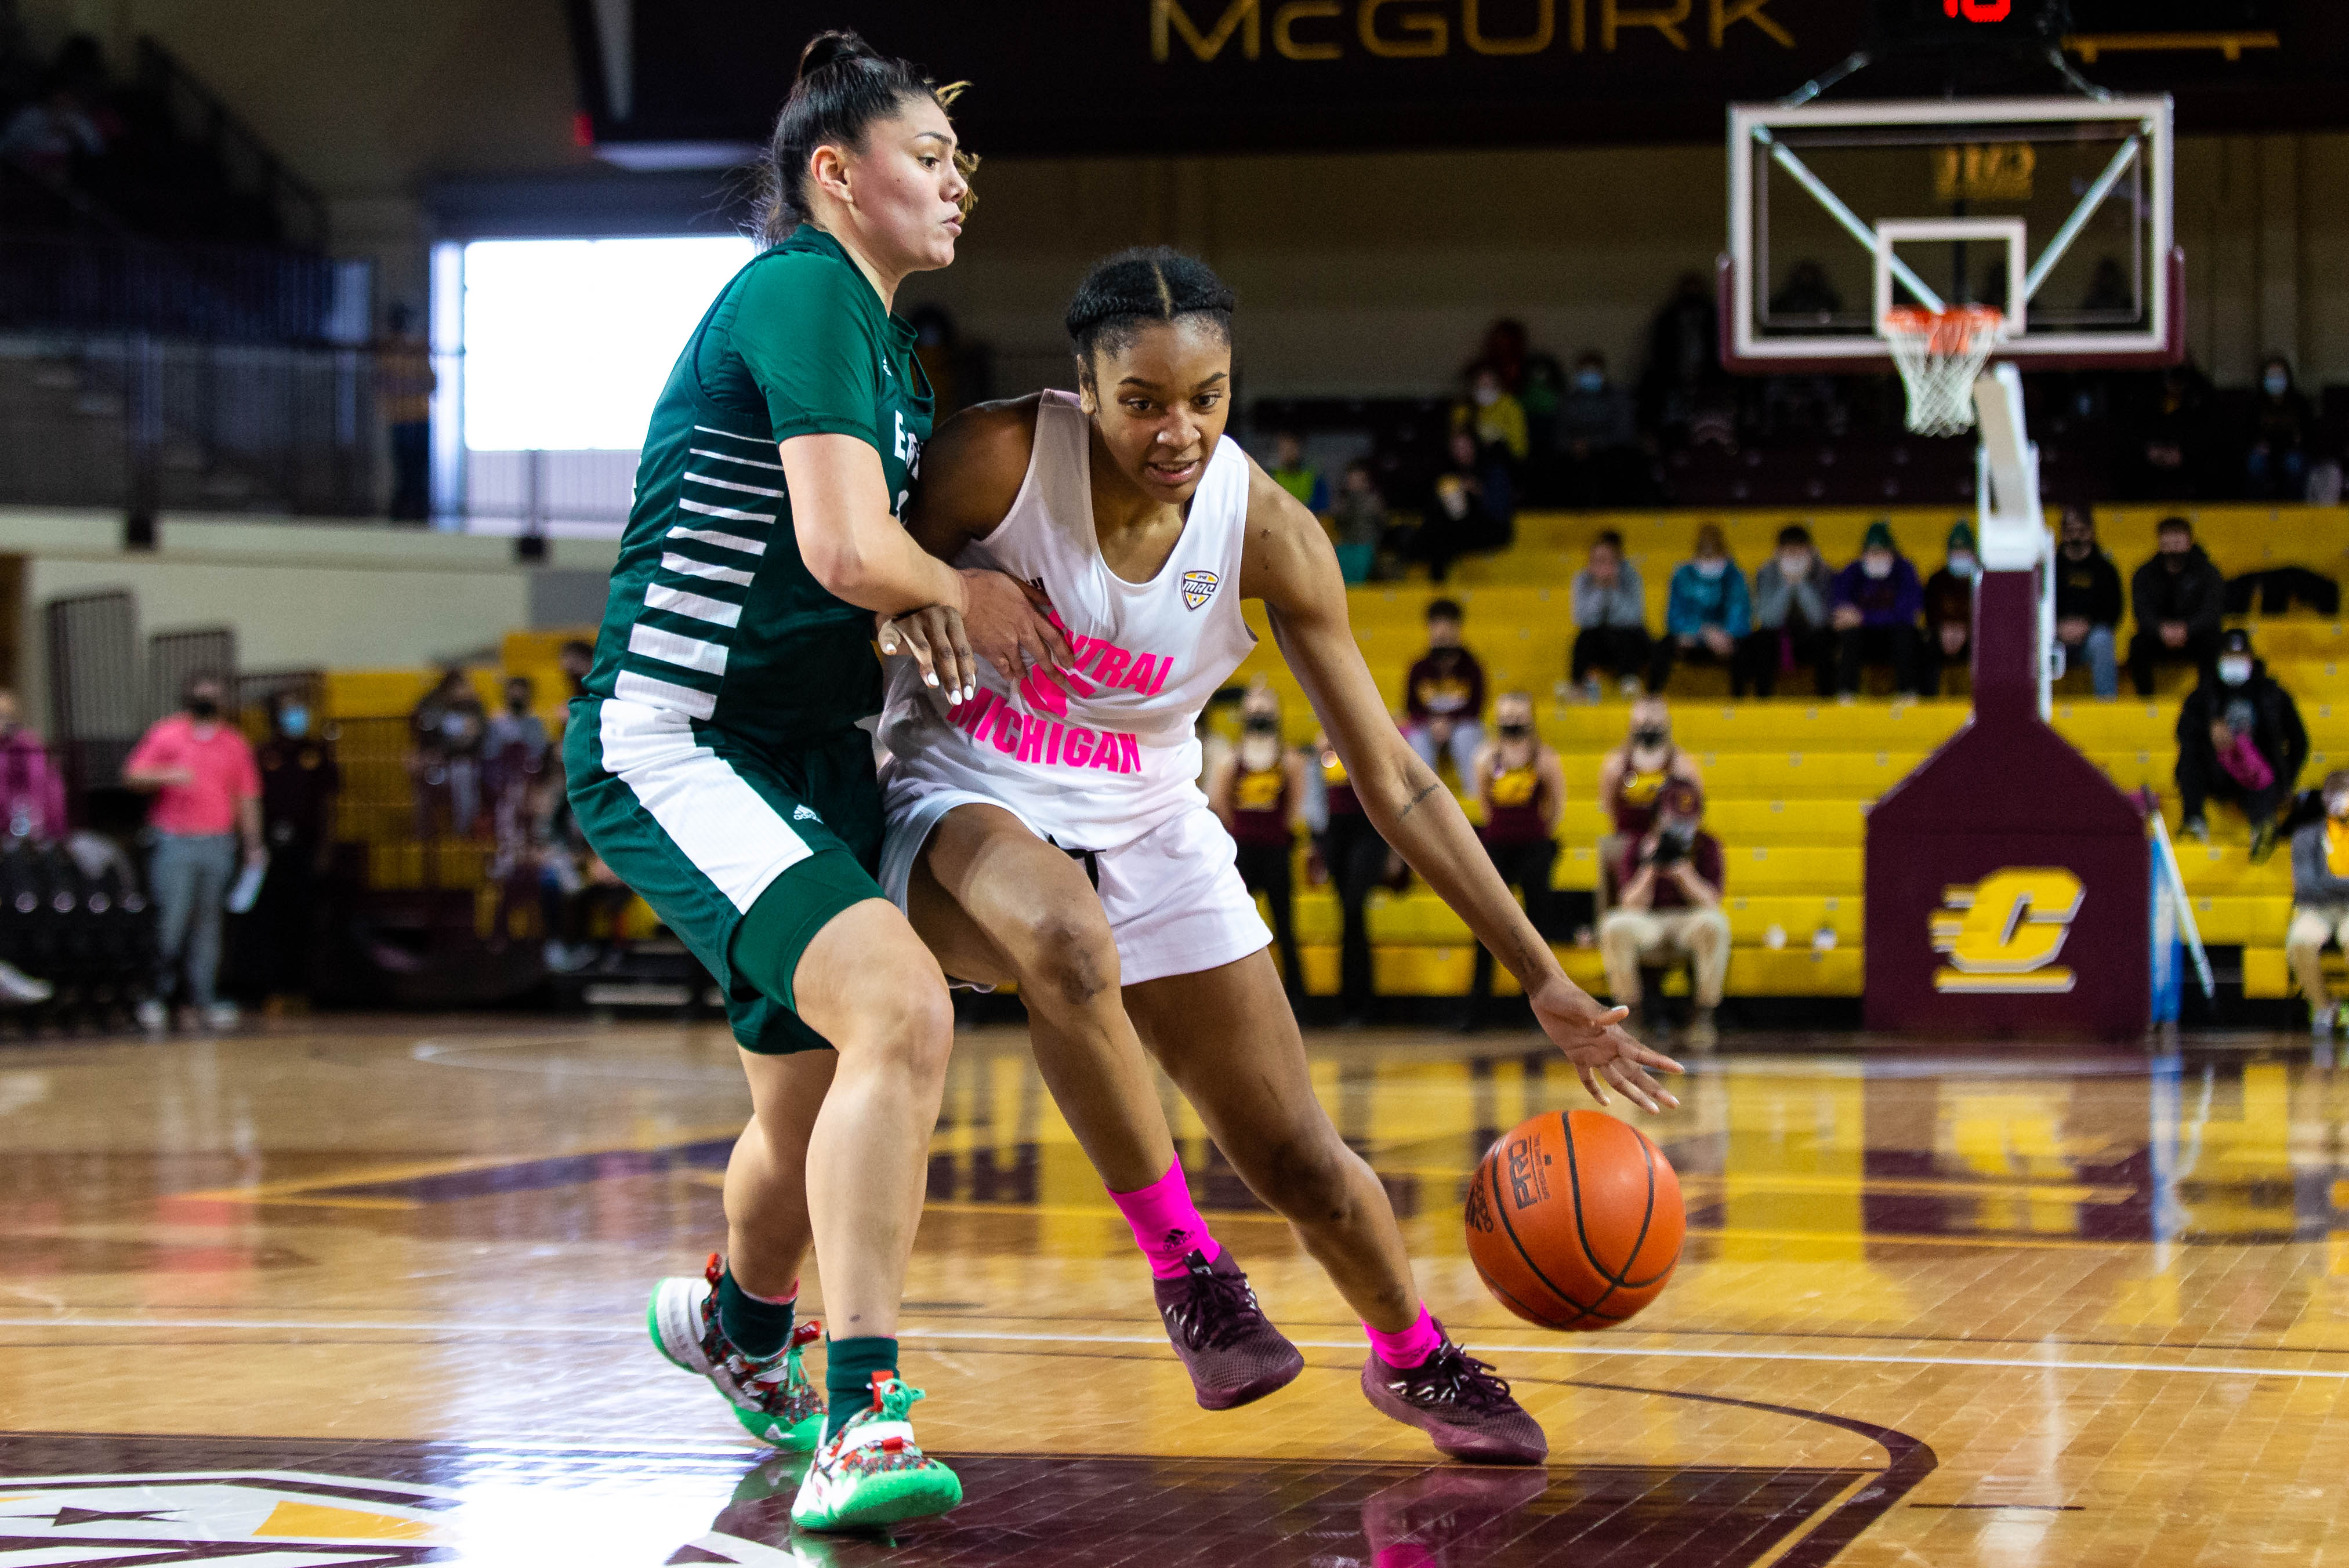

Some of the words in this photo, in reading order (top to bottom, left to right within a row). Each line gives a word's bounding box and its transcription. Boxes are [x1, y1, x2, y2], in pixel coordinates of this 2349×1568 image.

[1183, 581, 1216, 596] MAC
[946, 687, 1141, 774] MICHIGAN
[1508, 1138, 1538, 1210] PRO
